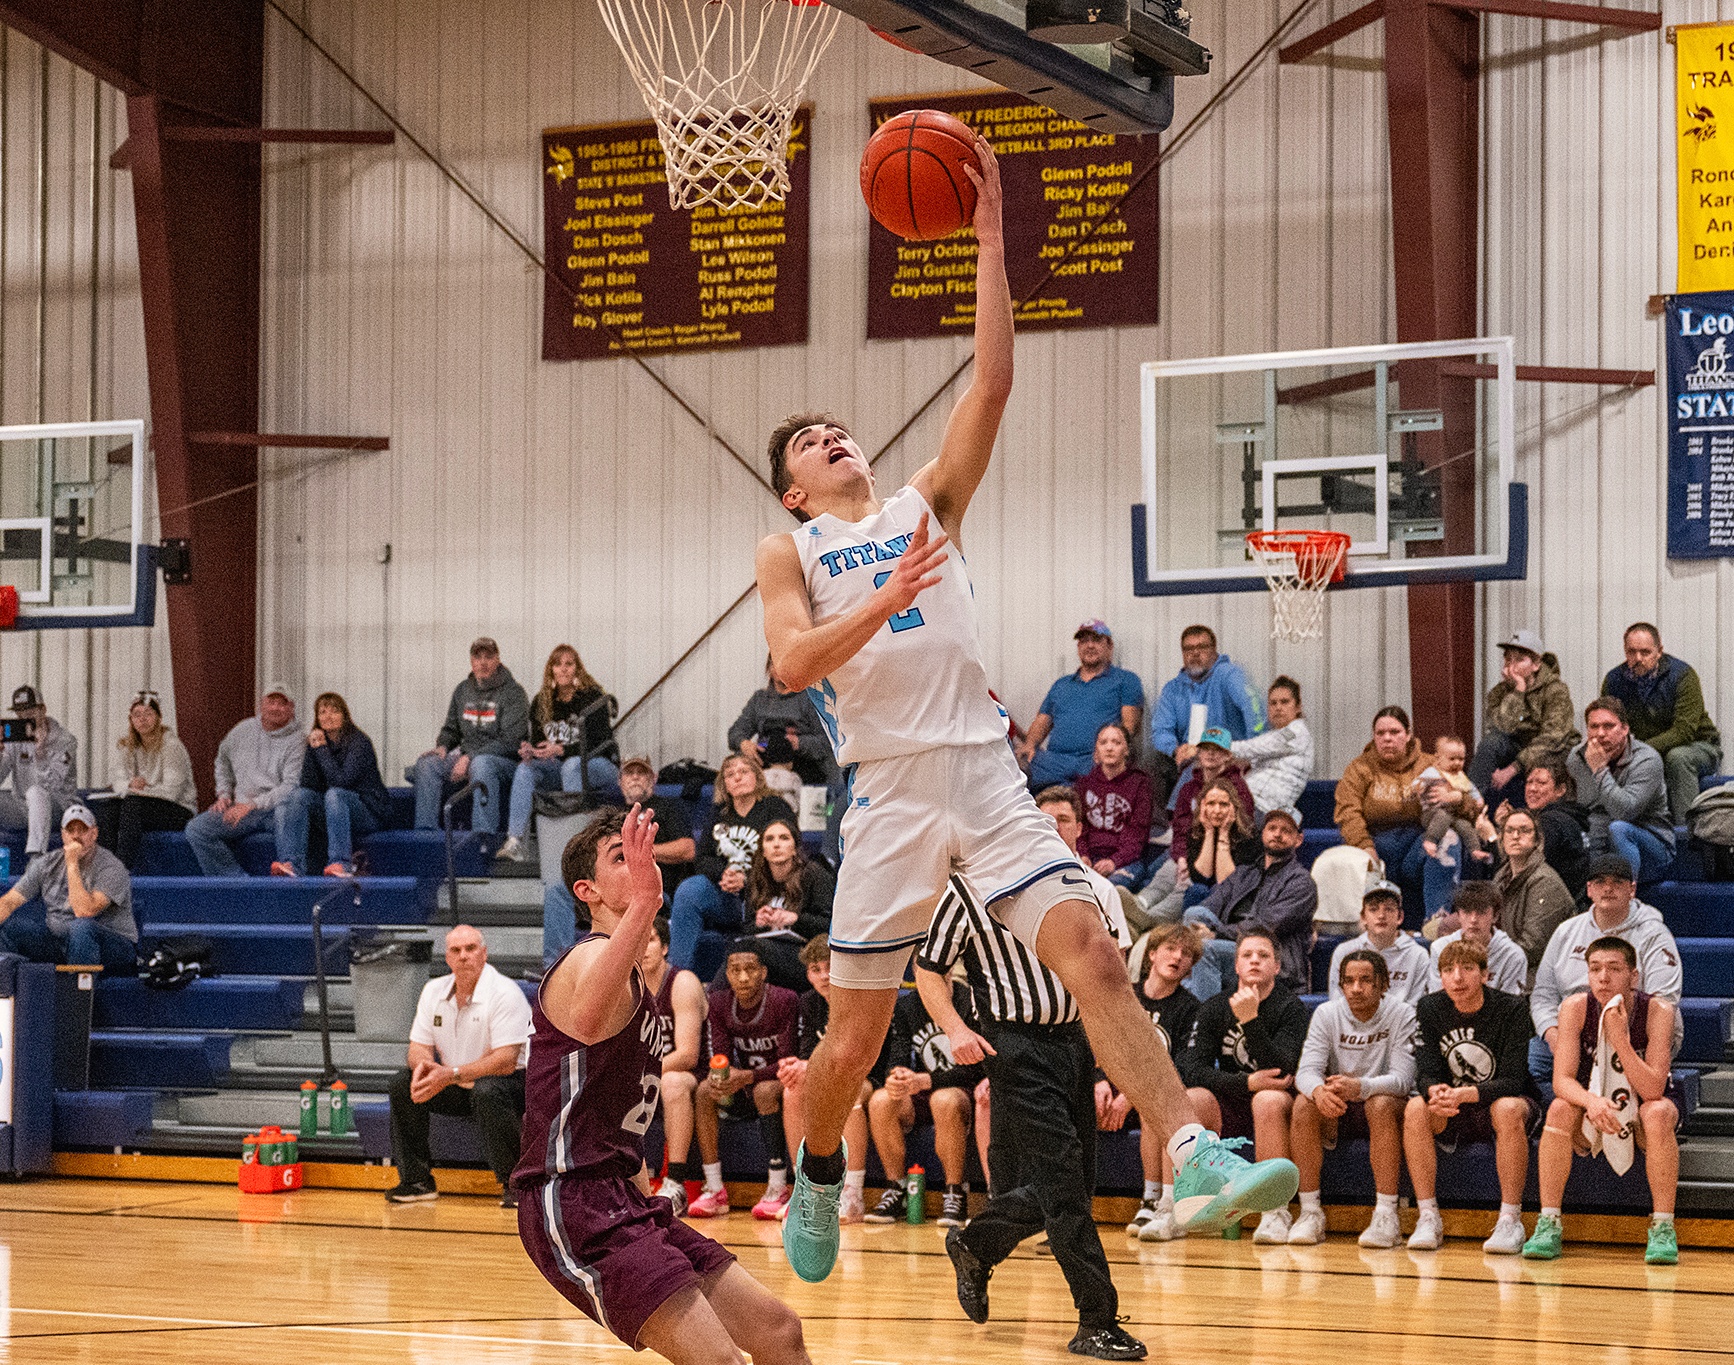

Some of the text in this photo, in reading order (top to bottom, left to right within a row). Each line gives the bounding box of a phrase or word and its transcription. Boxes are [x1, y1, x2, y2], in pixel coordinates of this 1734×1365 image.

[1688, 70, 1734, 89] TRA
[995, 122, 1045, 137] REGION
[1048, 137, 1073, 149] 3RD
[1075, 134, 1115, 147] PLACE
[1041, 161, 1132, 182] Glenn Podoll
[575, 193, 643, 211] Steve Post
[1044, 186, 1084, 202] Ricky
[1700, 193, 1734, 207] Kar
[1056, 204, 1083, 219] Jim
[564, 215, 591, 231] Joel
[691, 219, 735, 235] Darrell
[1707, 218, 1734, 233] An
[1048, 224, 1078, 239] Dan
[573, 231, 643, 250] Dan Dosch
[690, 237, 720, 252] Stan
[567, 250, 650, 269] Glenn Podoll
[897, 243, 979, 262] Terry Ochsn
[1038, 245, 1065, 258] Joe
[698, 264, 778, 283] Russ Podoll
[894, 261, 977, 279] Jim Gustafs
[1090, 258, 1124, 274] Post
[580, 271, 637, 288] Jim Bain
[604, 291, 643, 305] Kotila
[890, 280, 976, 300] Clayton Fisc
[701, 298, 775, 319] Lyle Podoll
[1678, 306, 1734, 336] Leo
[819, 531, 916, 578] TITAN
[1340, 1028, 1390, 1045] WOLVES
[300, 1096, 310, 1110] G
[331, 1096, 342, 1110] G
[283, 1169, 293, 1187] G
[907, 1180, 919, 1196] G
